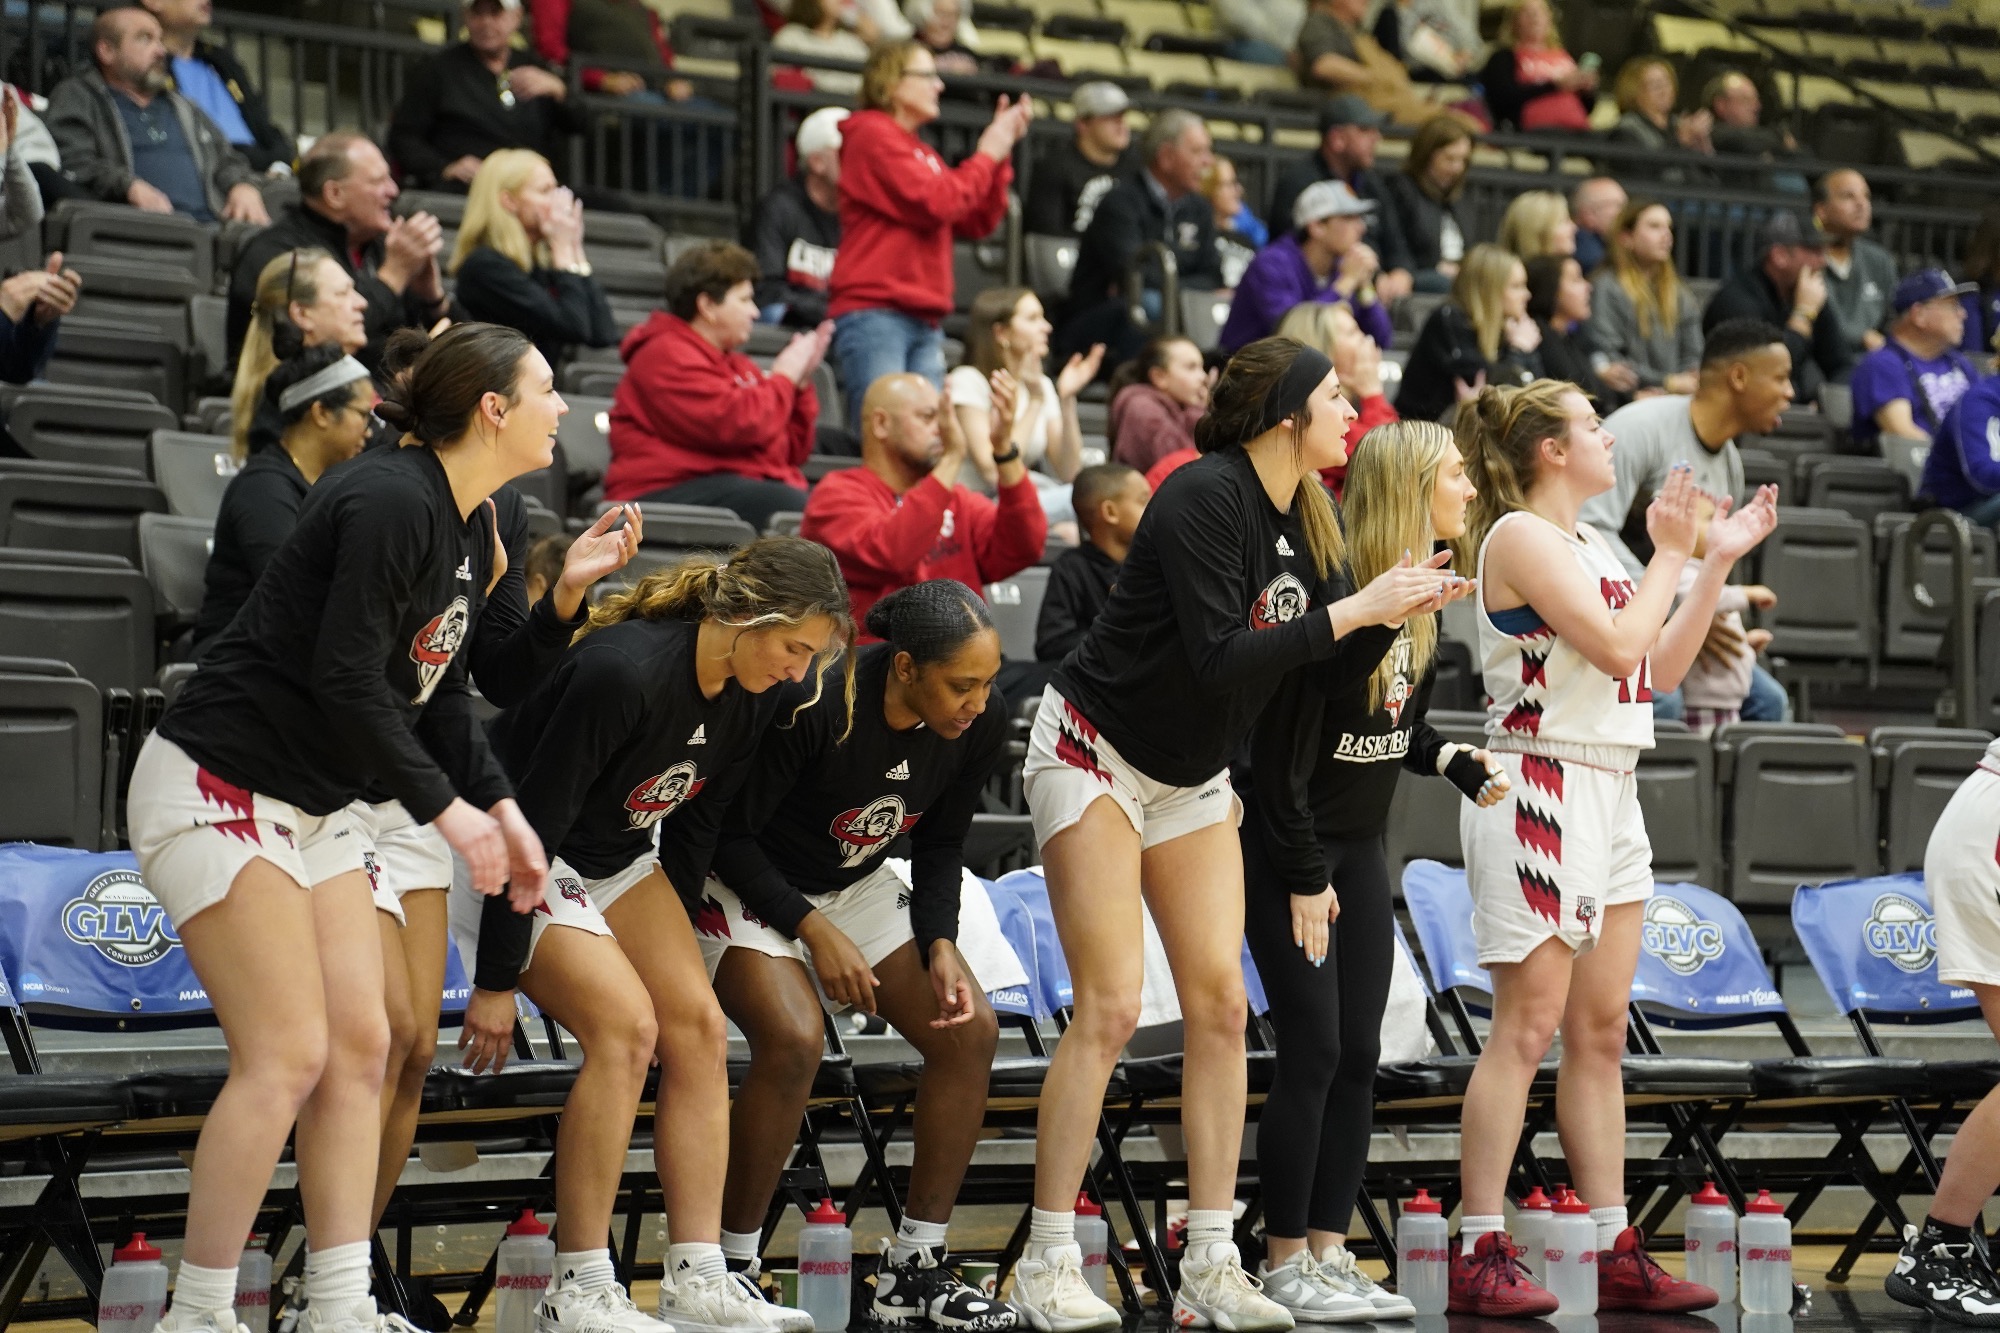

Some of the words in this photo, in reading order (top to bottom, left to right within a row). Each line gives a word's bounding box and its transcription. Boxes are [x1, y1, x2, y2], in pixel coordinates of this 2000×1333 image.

[1335, 726, 1413, 758] BASKETBA
[89, 879, 109, 898] GREAT
[1642, 921, 1721, 956] GLVC
[106, 947, 160, 962] CONFERENCE
[179, 990, 207, 1001] MAK
[442, 989, 456, 999] KE
[458, 988, 469, 998] IT
